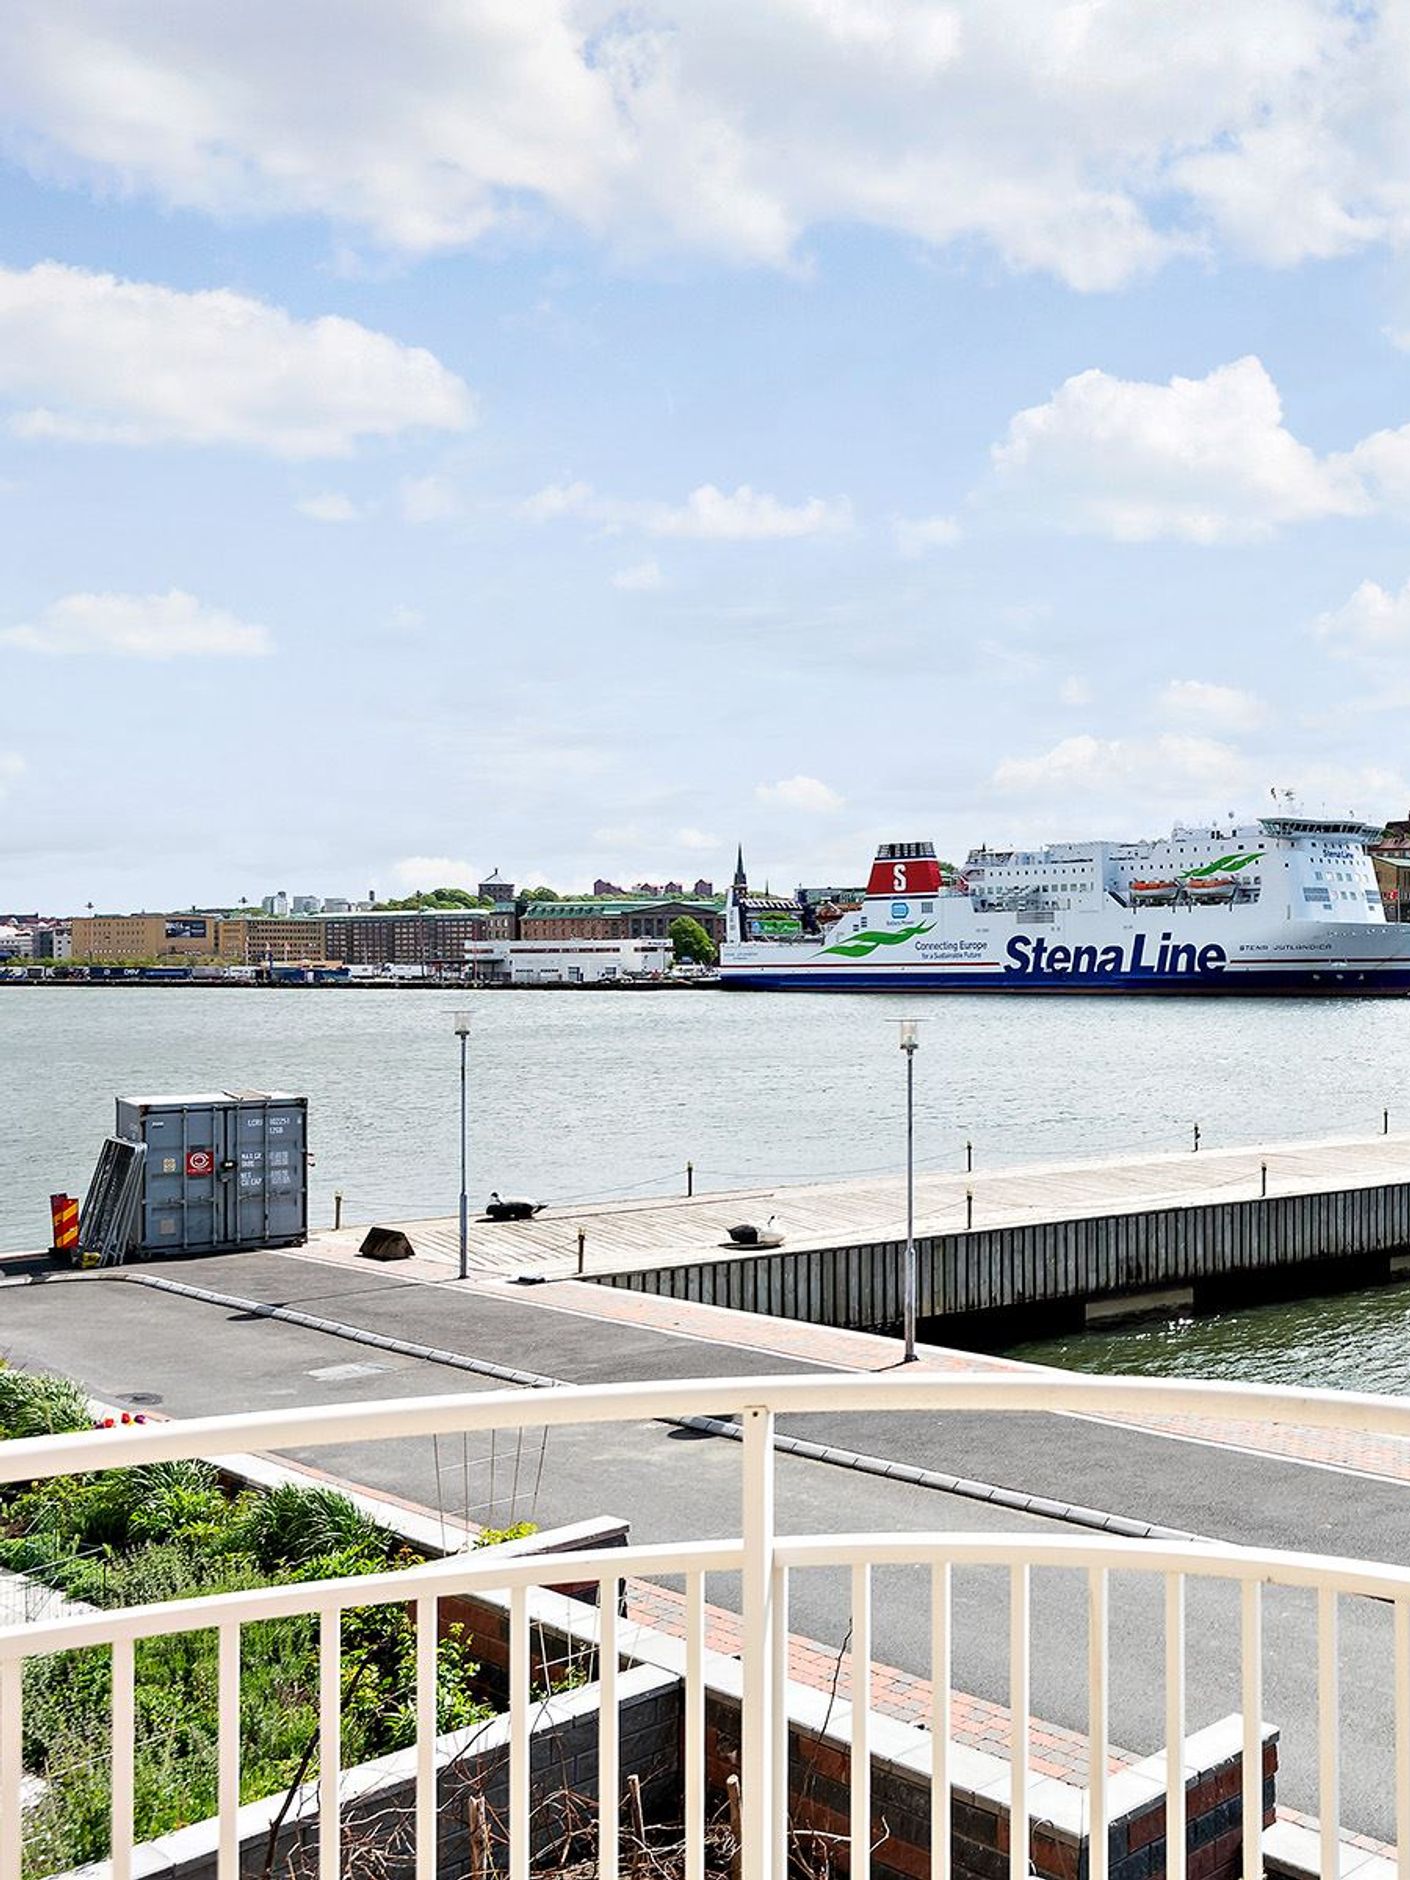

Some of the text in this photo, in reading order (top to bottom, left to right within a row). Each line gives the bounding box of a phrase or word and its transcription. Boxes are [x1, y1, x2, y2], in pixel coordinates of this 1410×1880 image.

[893, 863, 907, 892] S
[914, 940, 988, 952] Connecting Europe
